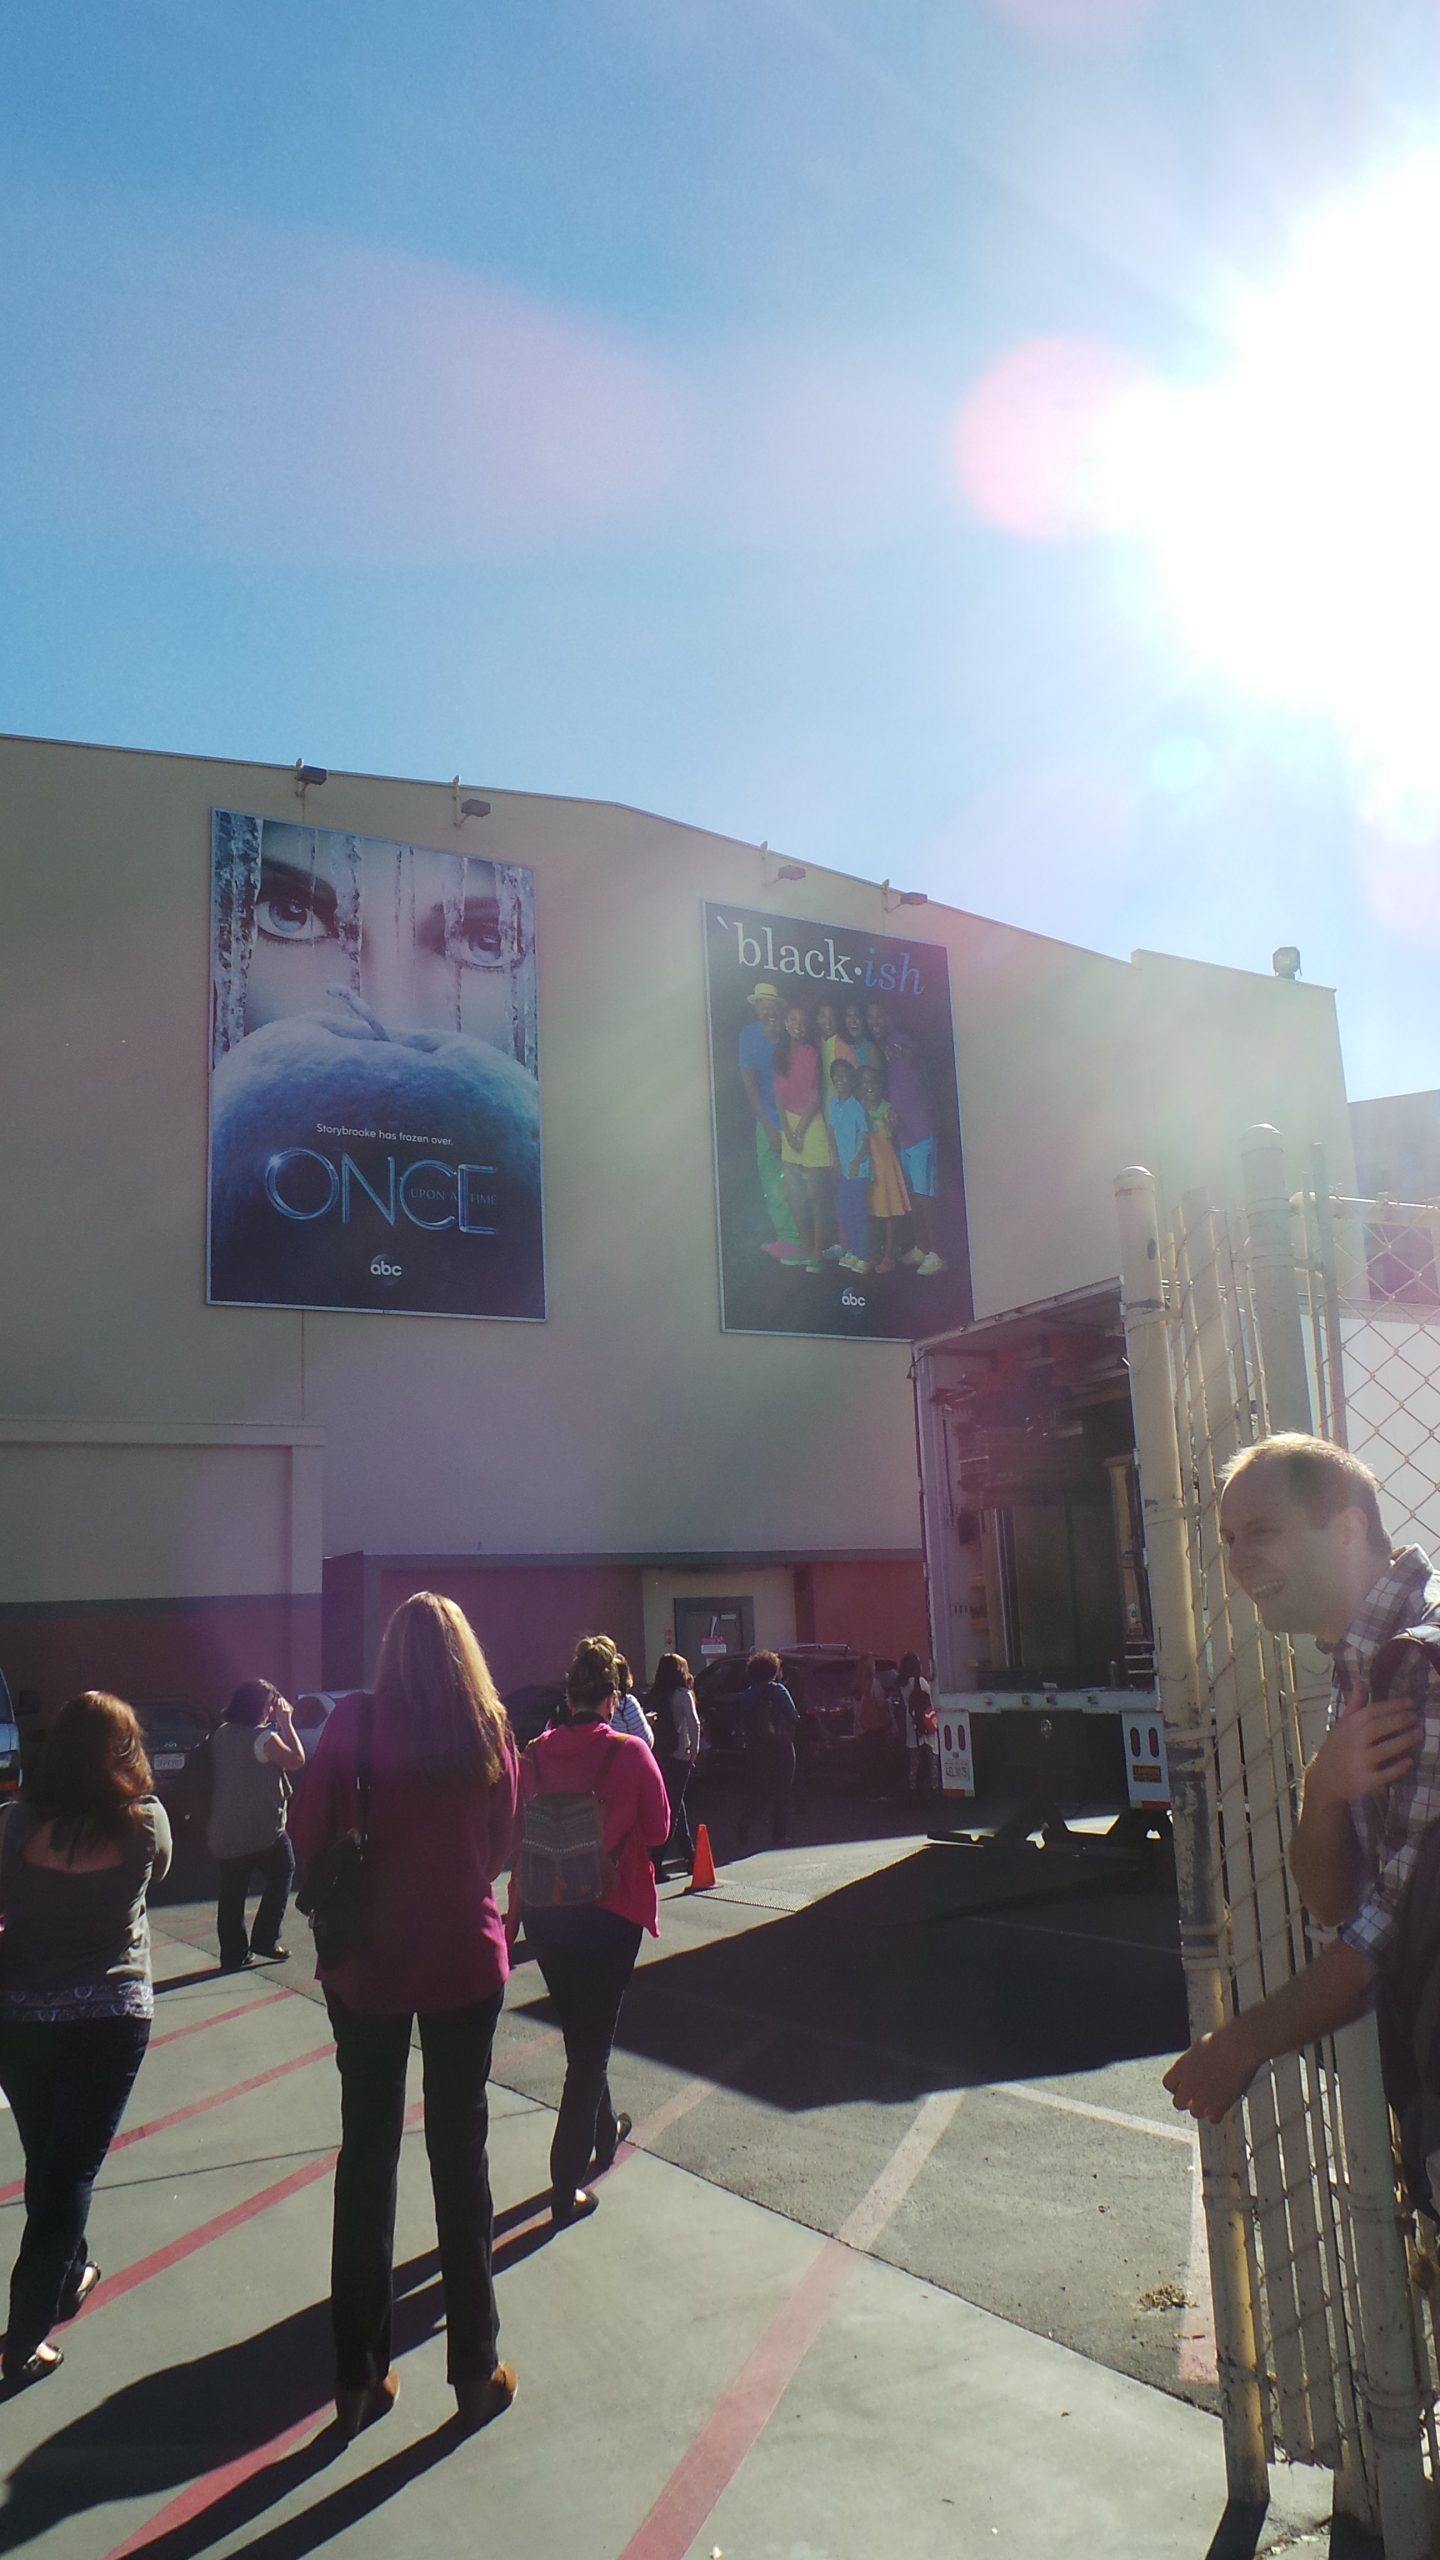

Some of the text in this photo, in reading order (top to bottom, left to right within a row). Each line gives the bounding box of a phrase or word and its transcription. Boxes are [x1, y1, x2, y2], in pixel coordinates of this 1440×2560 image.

[316, 1123, 377, 1138] Storybrooke
[379, 1129, 397, 1141] has
[399, 1131, 429, 1144] frozen
[265, 1148, 497, 1235] ONCE
[410, 1187, 497, 1206] UPON A TIME
[370, 1260, 402, 1276] abc
[841, 1292, 866, 1306] abc
